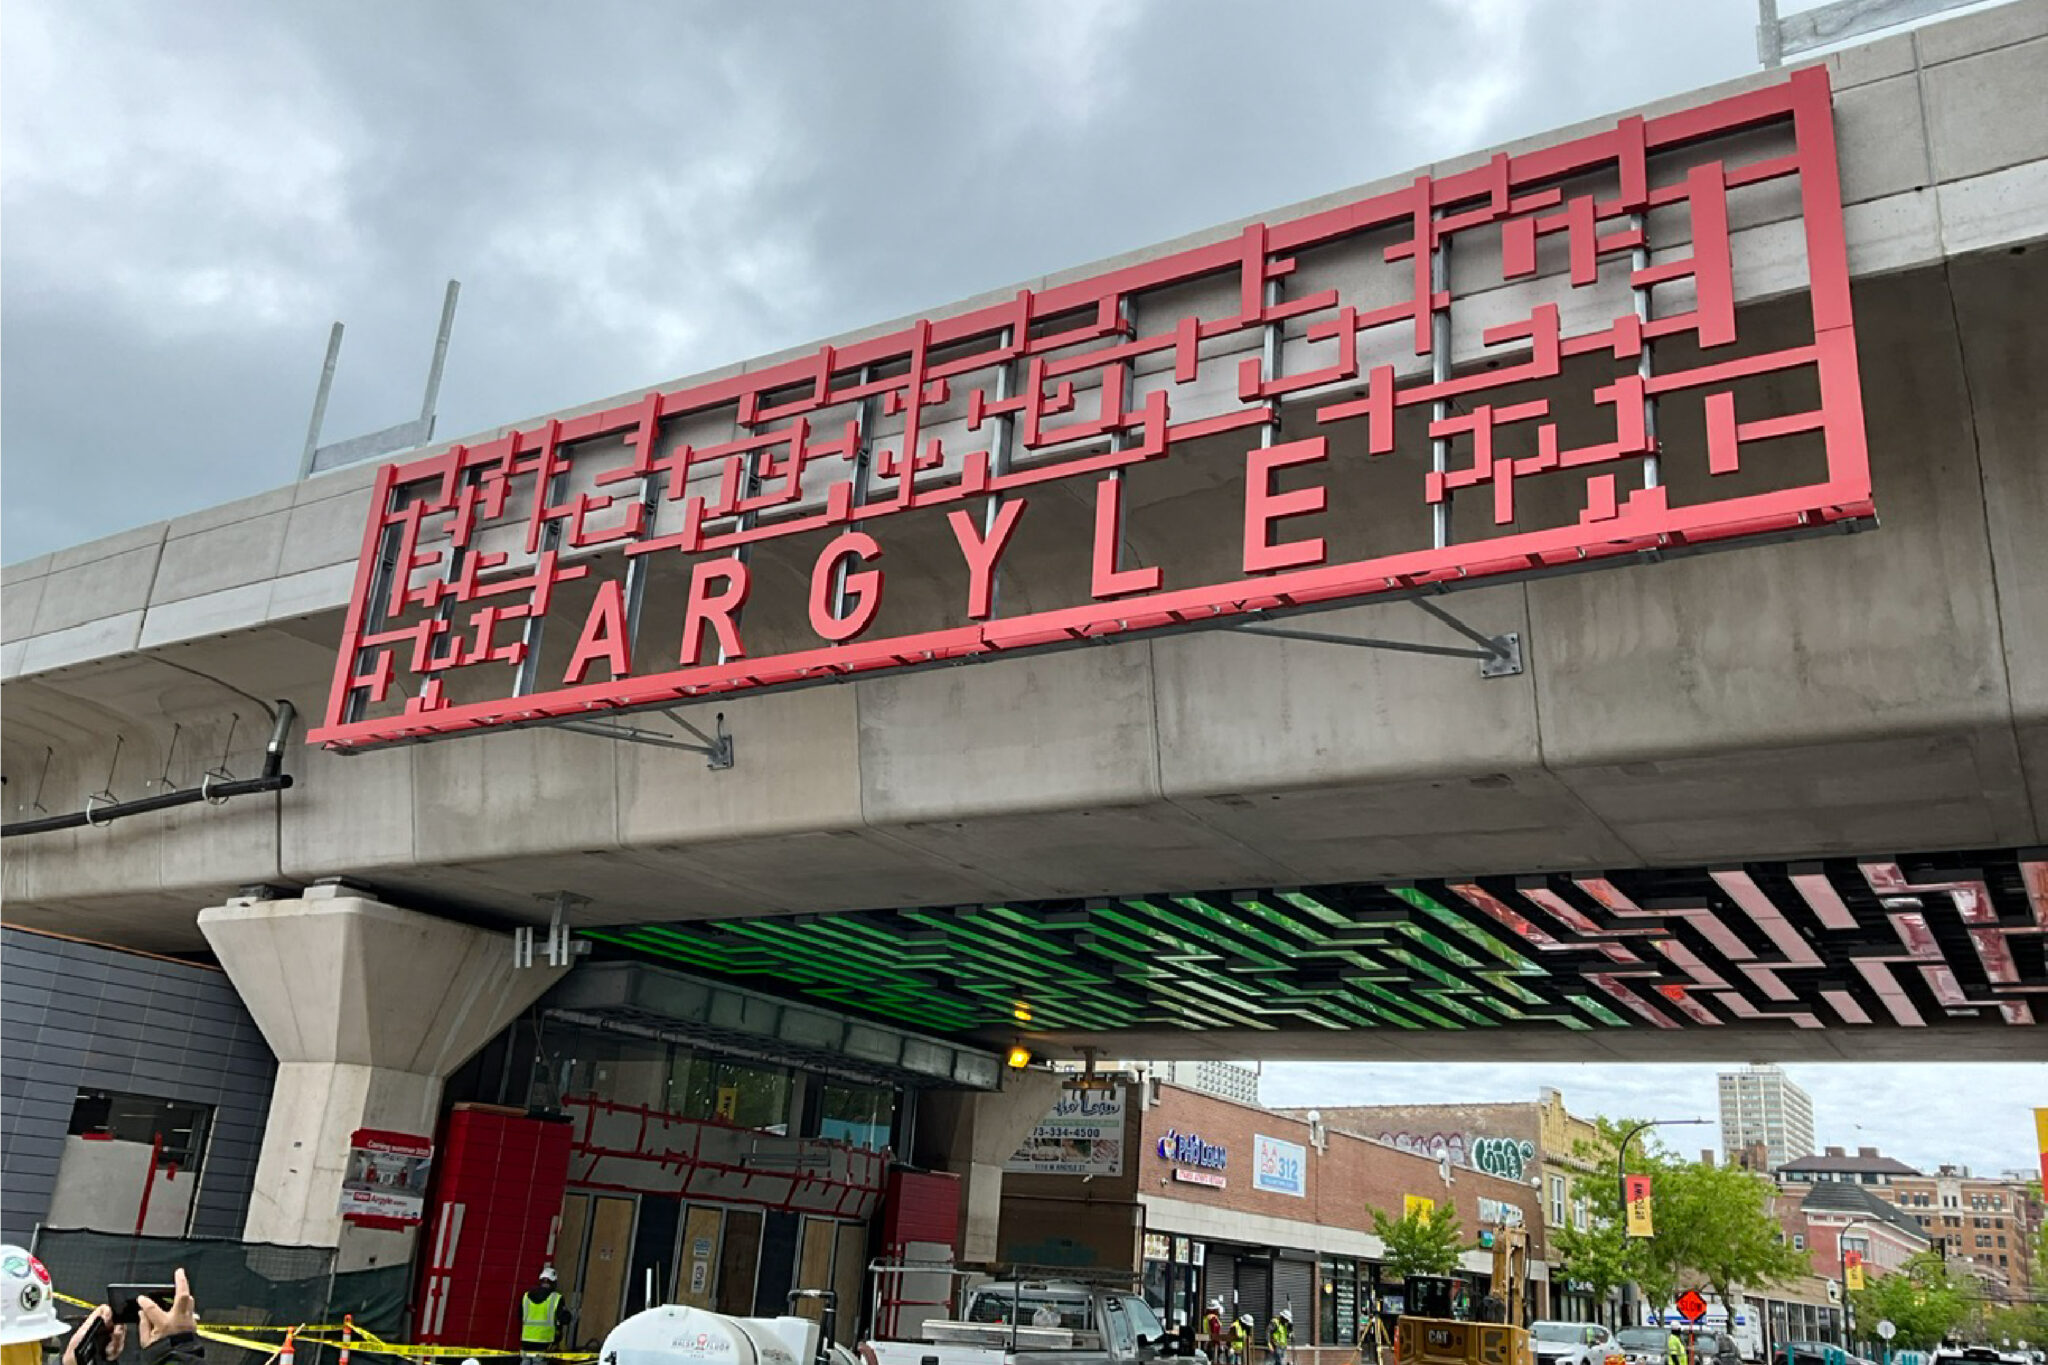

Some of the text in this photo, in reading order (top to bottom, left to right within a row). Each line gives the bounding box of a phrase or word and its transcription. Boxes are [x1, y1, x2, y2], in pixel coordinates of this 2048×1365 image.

[562, 436, 1327, 684] ARGYLE
[1279, 1157, 1298, 1180] 312
[1681, 1302, 1702, 1312] SLOW
[1428, 1330, 1449, 1344] CAT
